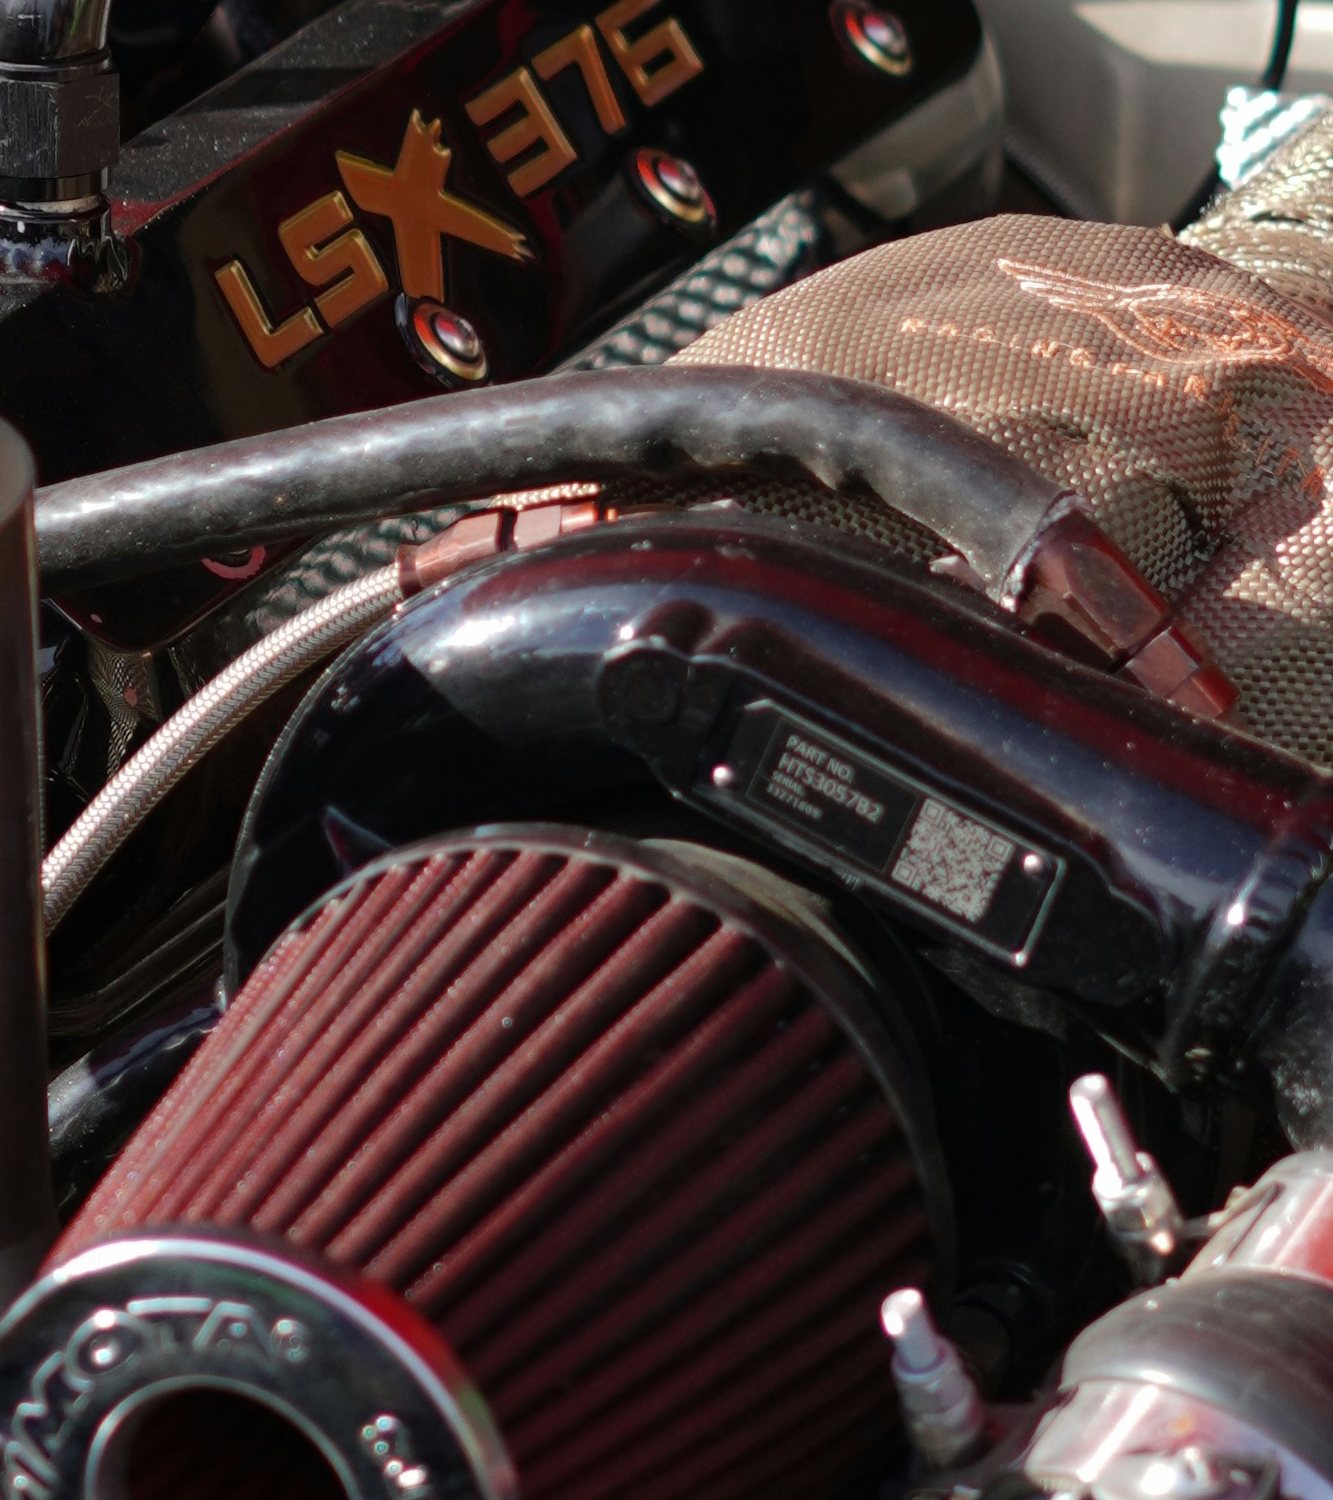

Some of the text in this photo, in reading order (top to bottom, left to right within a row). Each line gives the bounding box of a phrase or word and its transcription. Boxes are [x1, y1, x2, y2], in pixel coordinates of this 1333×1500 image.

[213, 107, 537, 370] LSX
[785, 734, 828, 766] PART
[777, 752, 885, 824] HTS3057B2
